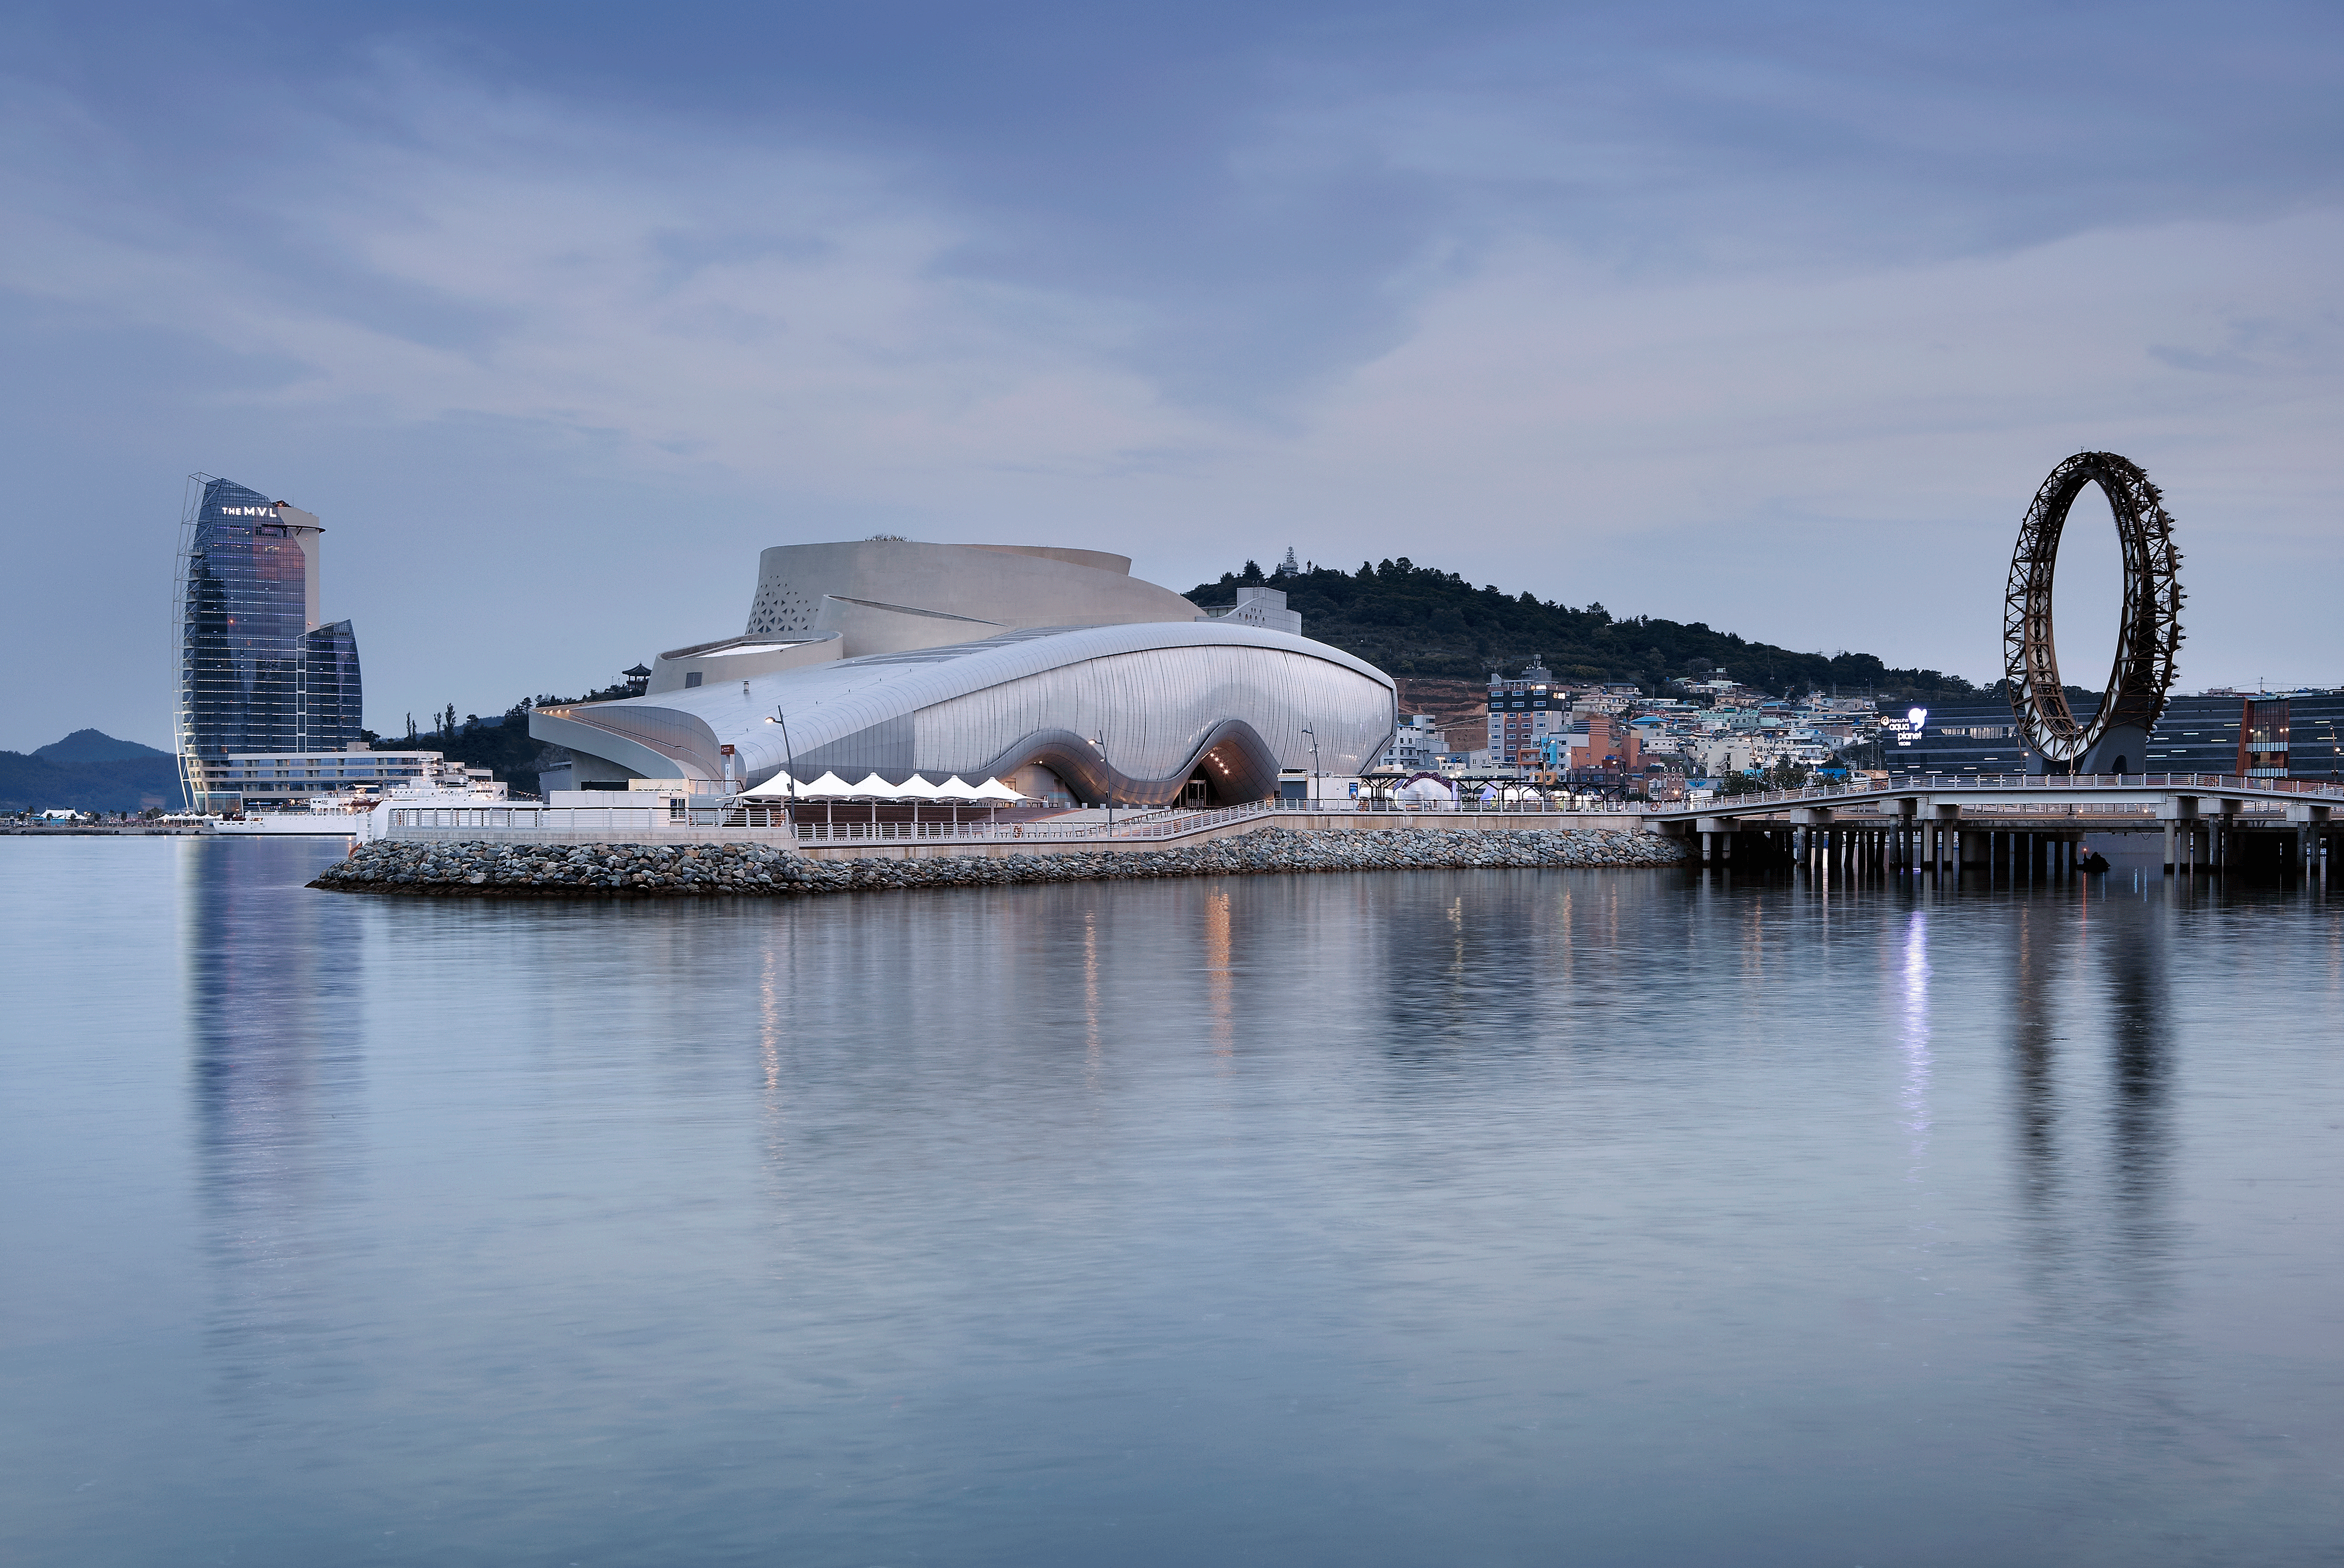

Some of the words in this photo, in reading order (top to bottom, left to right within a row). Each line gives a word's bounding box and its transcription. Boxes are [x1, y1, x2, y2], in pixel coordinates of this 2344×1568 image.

[222, 507, 241, 515] THE
[244, 506, 277, 517] MVL
[1889, 724, 1909, 732] aqua
[1897, 731, 1922, 742] planet
